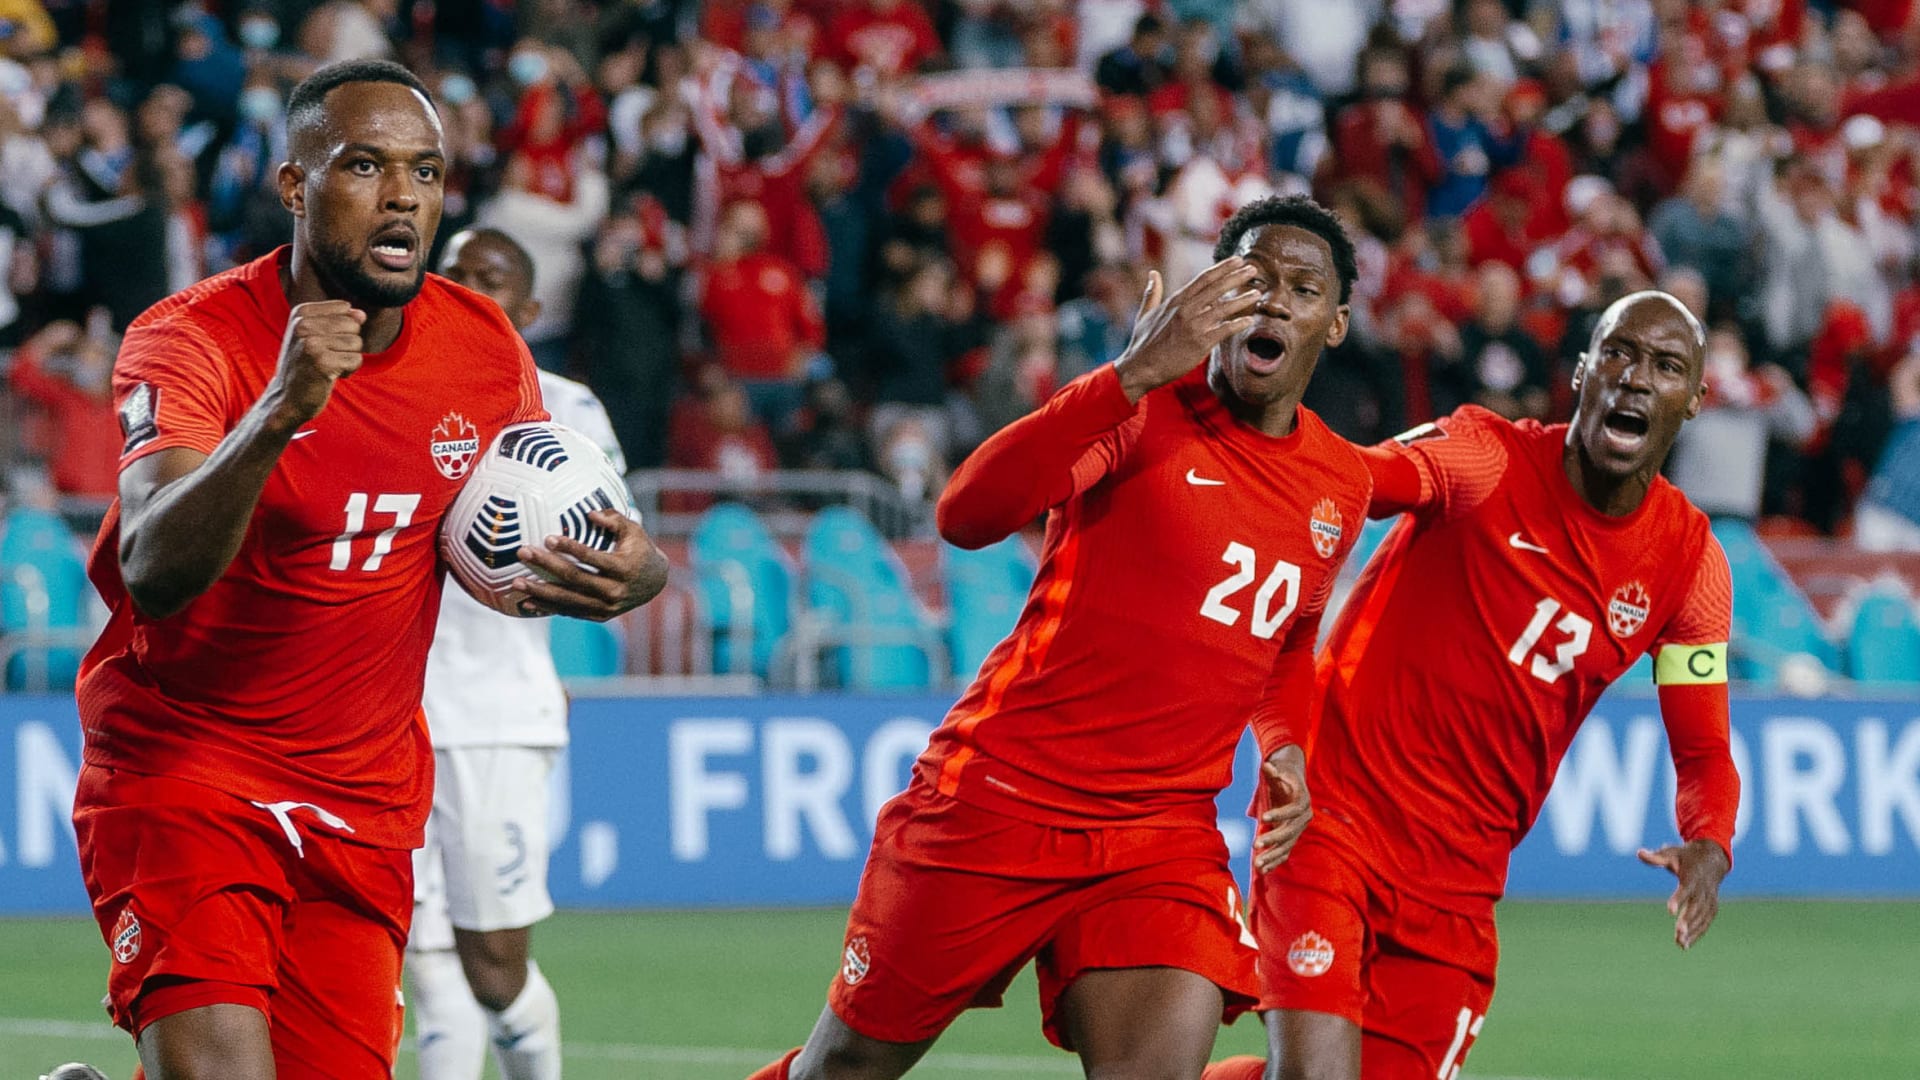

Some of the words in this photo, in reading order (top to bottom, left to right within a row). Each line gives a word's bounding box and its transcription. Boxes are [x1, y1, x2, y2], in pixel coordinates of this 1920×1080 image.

[432, 441, 478, 454] CANADA
[329, 492, 422, 572] 17
[1311, 521, 1340, 537] CANADA
[1199, 540, 1301, 640] 20
[1610, 602, 1645, 619] CANADA
[1508, 597, 1593, 685] 13
[1688, 649, 1715, 677] C
